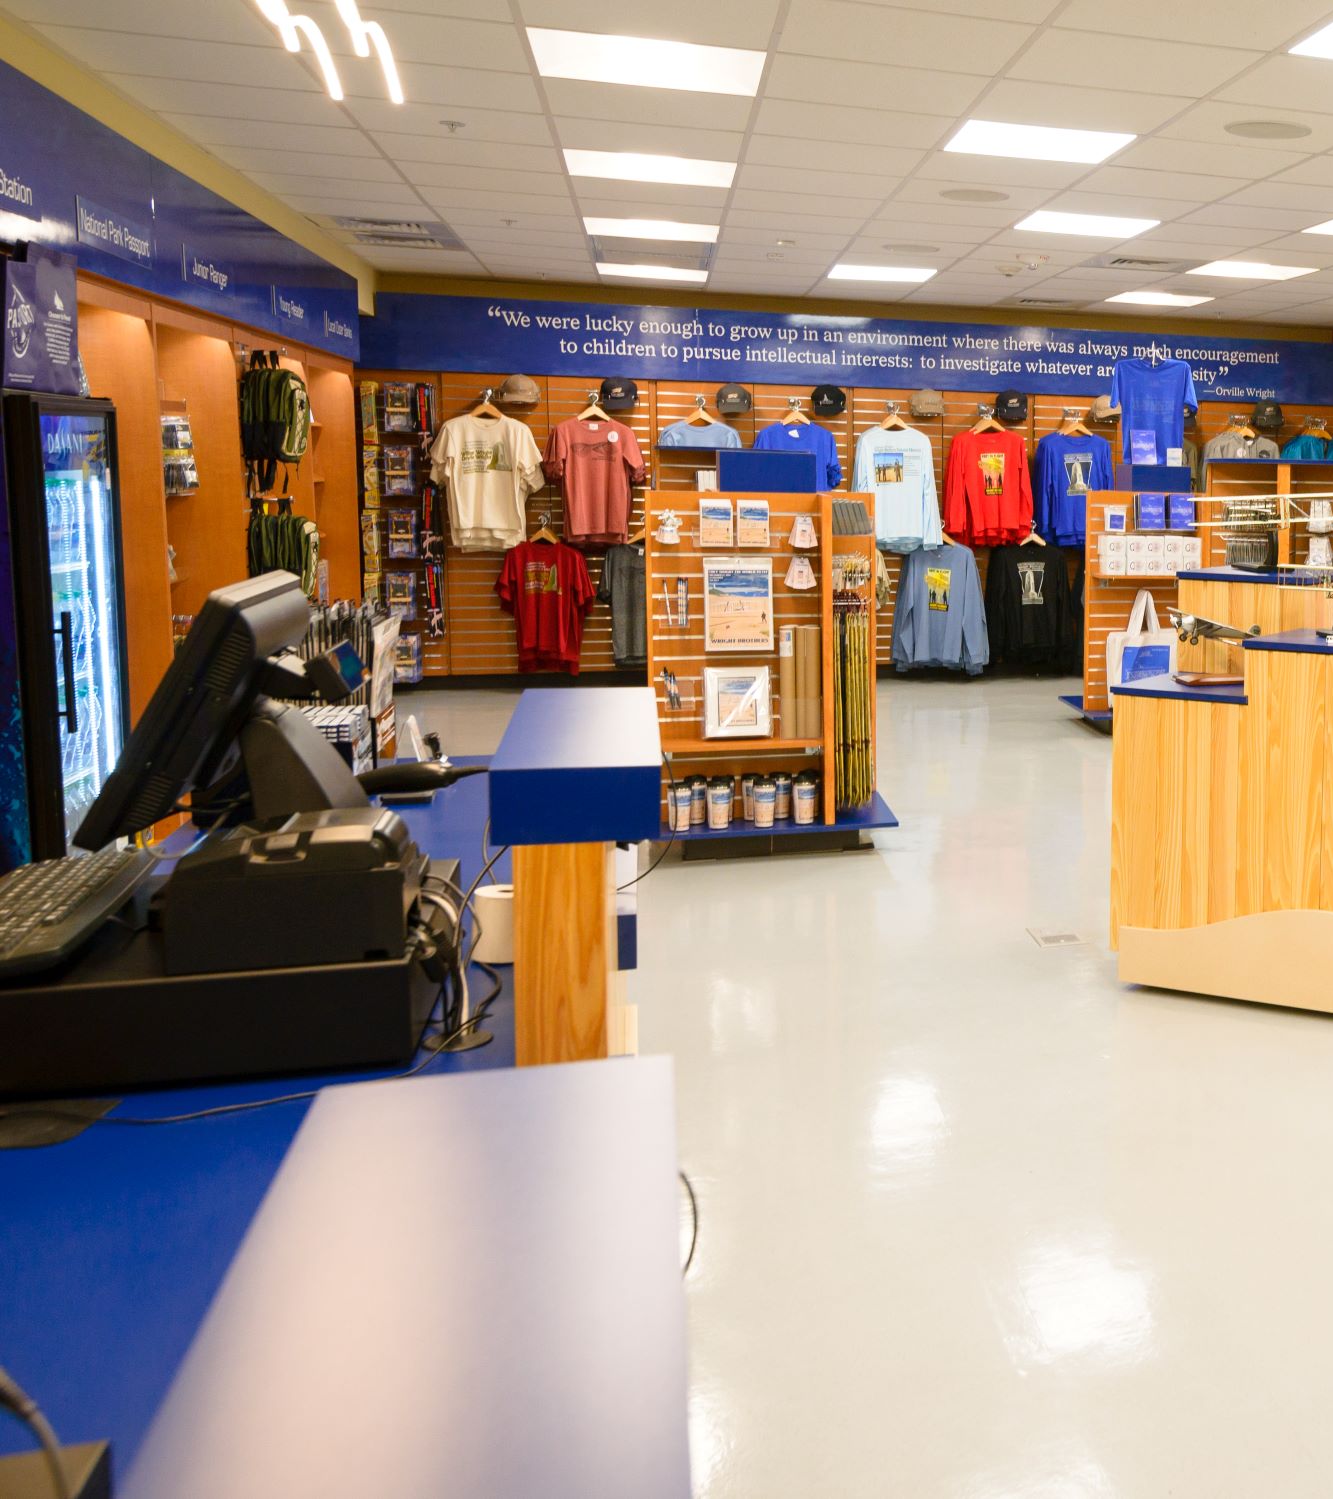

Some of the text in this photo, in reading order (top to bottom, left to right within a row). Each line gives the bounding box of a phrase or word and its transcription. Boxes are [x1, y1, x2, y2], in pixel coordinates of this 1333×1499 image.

[80, 207, 150, 259] National Park Passport
[193, 257, 228, 291] Junior Ranger
[536, 315, 580, 330] were
[585, 314, 634, 337] lucky
[639, 319, 704, 339] enough
[708, 322, 726, 337] to
[730, 325, 773, 342] grow
[777, 328, 799, 344] up
[803, 325, 819, 342] in
[824, 331, 844, 343] an
[848, 330, 948, 348] environment
[952, 334, 1000, 351] where
[1003, 336, 1042, 353] there
[1046, 341, 1075, 355] was
[1078, 340, 1128, 360] always
[1175, 349, 1280, 365] encouragement
[560, 338, 578, 354] to
[583, 338, 656, 358] children
[661, 343, 678, 358] to
[683, 346, 741, 363] pursue
[746, 345, 836, 366] intellectual
[841, 350, 913, 369] interests:
[920, 355, 936, 370] to
[940, 354, 1022, 376] investigate
[1025, 358, 1094, 377] whatever
[1246, 387, 1276, 400] Wright
[47, 428, 83, 458] DASANI
